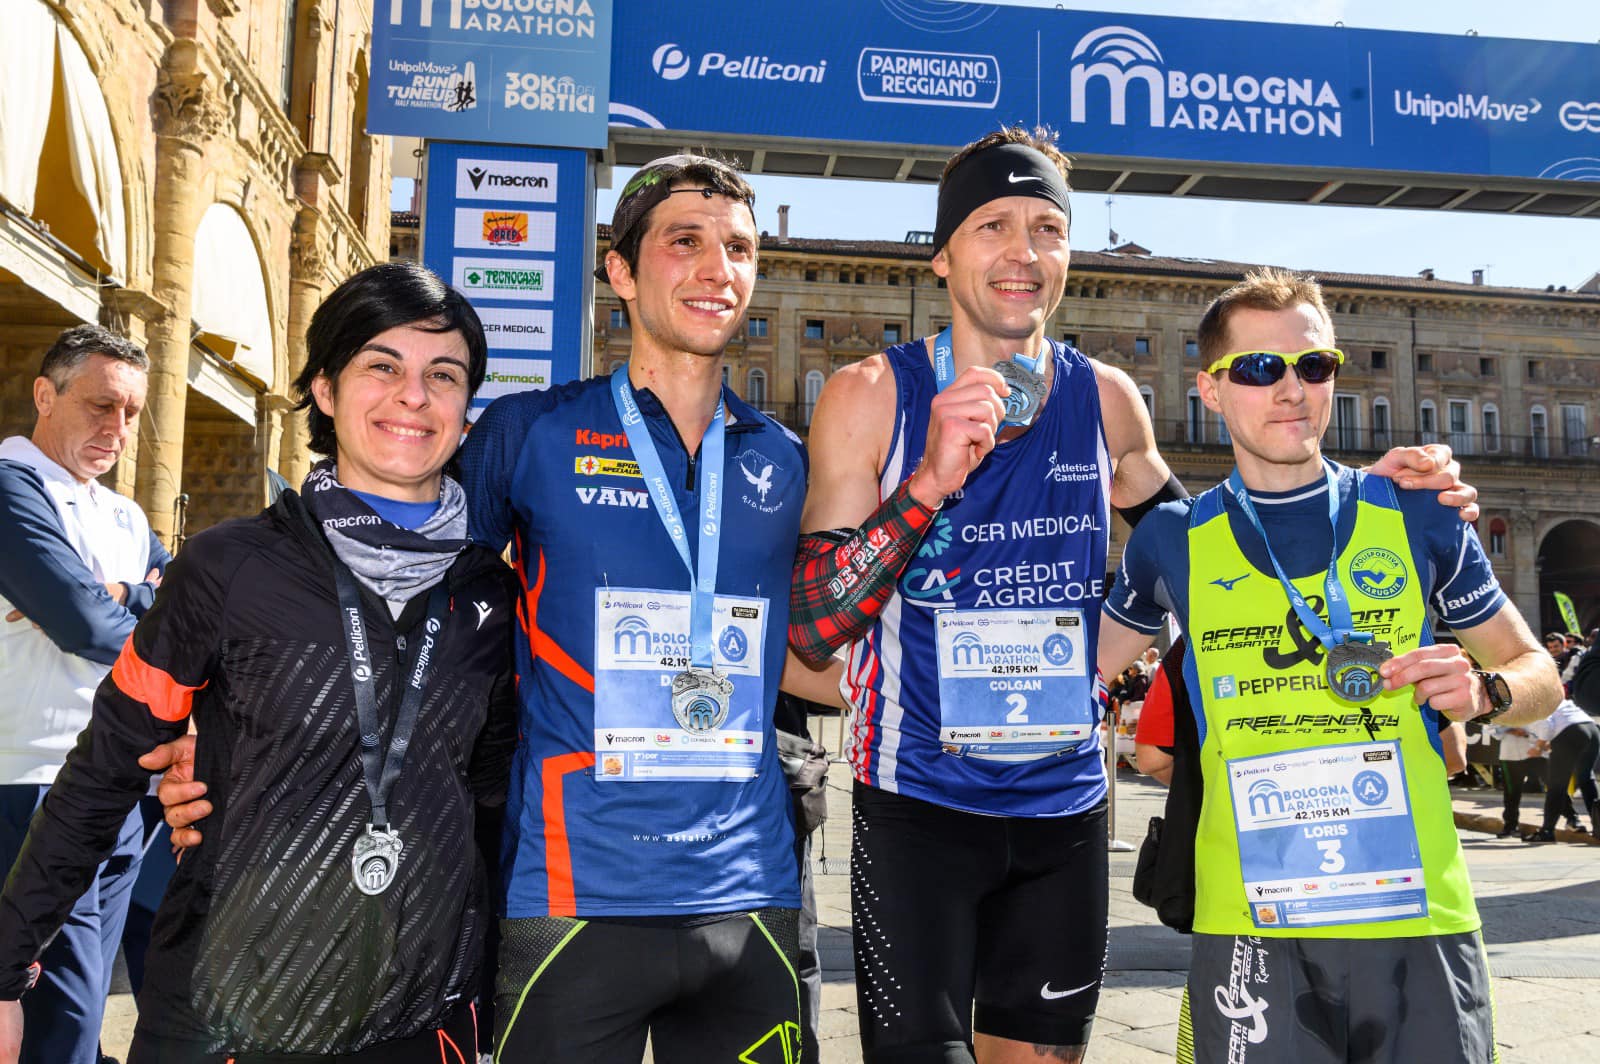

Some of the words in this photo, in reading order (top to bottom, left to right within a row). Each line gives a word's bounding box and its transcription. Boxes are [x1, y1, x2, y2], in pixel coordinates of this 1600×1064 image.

[464, 12, 595, 39] ARATHON
[389, 60, 451, 75] UnipolMove
[698, 52, 827, 84] Pelliconi
[870, 55, 988, 79] PARMIGIANO
[412, 75, 450, 88] RUN
[882, 75, 977, 98] REGGIANO
[1168, 70, 1341, 108] BOLOGNA
[387, 85, 457, 102] TUNEUP
[504, 90, 595, 114] PORTICI
[1394, 90, 1529, 125] UnipolMove
[1169, 103, 1342, 137] ARATHON
[488, 174, 548, 189] macron
[494, 228, 518, 241] PREP
[485, 270, 541, 286] TECNOCASA
[482, 324, 501, 332] CER
[503, 325, 545, 334] MEDICAL
[485, 371, 544, 383] sFarmacia
[575, 429, 629, 450] Kapri
[1056, 463, 1097, 473] Atletica
[576, 487, 648, 509] VAM
[653, 477, 677, 522] Pelliconi
[705, 471, 719, 520] Pelliconi
[322, 515, 382, 529] macron
[961, 522, 1006, 543] CER
[1011, 514, 1102, 540] MEDICAL
[1355, 551, 1399, 567] POLISPORTIVA
[973, 560, 1075, 587] CRÉDIT
[974, 579, 1104, 608] AGRICOLE
[1361, 583, 1400, 597] CARUGATE
[346, 607, 367, 661] Pelliconi
[652, 632, 692, 645] BOLO
[1202, 625, 1284, 645] AFFARI
[653, 645, 692, 656] ARAT
[984, 644, 1040, 655] BOLOGNA
[1200, 640, 1280, 652] VILLASANTA
[411, 634, 434, 690] Pelliconi
[660, 657, 692, 668] 42,19
[985, 655, 1041, 665] ARATHON
[992, 666, 1021, 674] 42,195
[1023, 665, 1038, 673] KM
[989, 680, 1042, 691] COLGAN
[1239, 675, 1329, 697] PEPPERL
[1005, 693, 1029, 724] 2
[1284, 785, 1350, 801] BOLOGNA
[1286, 796, 1352, 812] ARATHON
[1295, 809, 1330, 821] 42,195
[1332, 807, 1350, 817] KM
[1304, 823, 1349, 839] LORIS
[1316, 839, 1345, 874] 3
[1228, 935, 1245, 1004] SPORT
